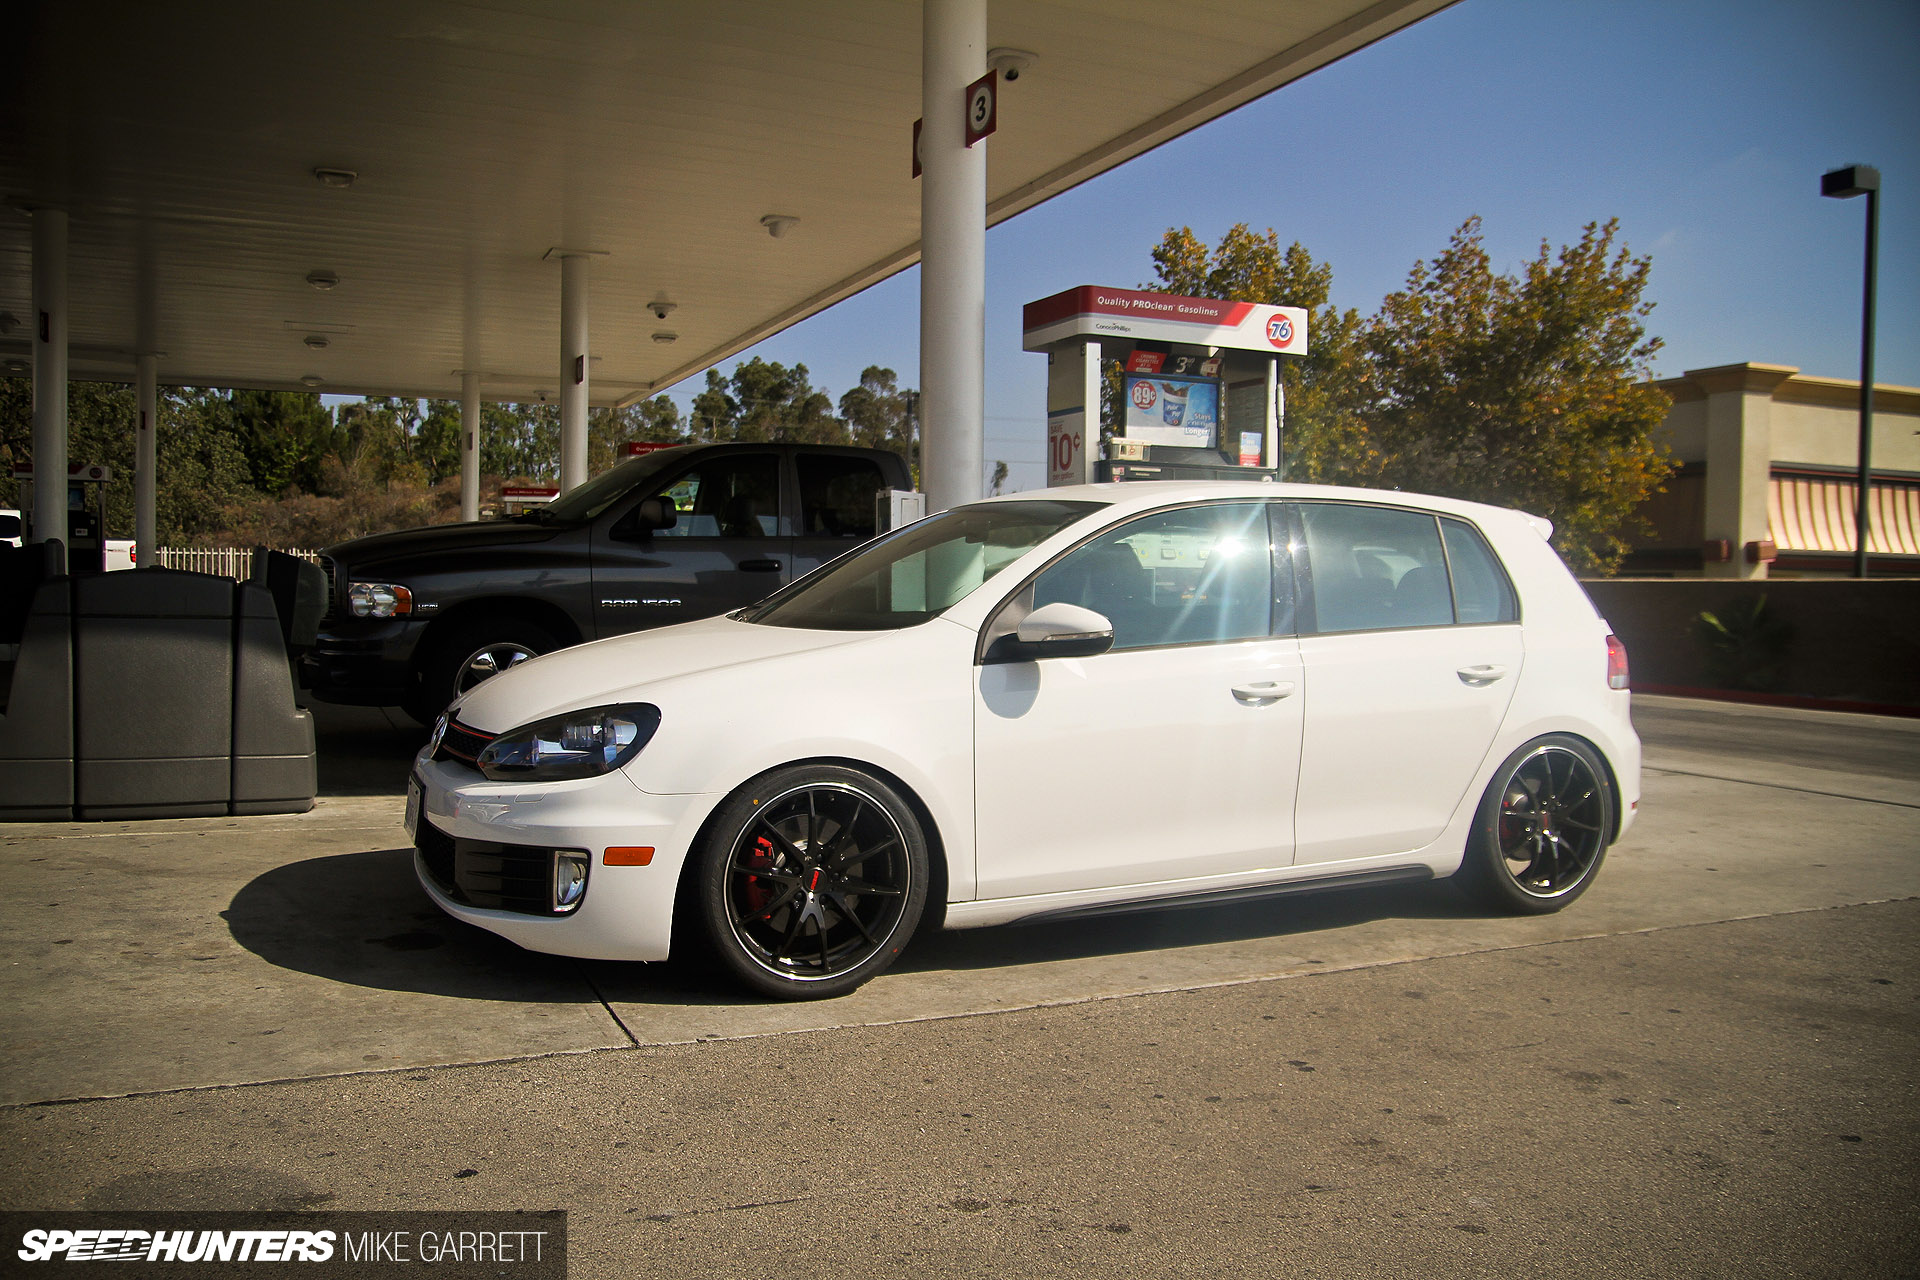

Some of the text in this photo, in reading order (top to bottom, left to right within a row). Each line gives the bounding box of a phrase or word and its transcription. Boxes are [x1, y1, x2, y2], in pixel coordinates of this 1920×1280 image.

[975, 95, 986, 122] 3
[1097, 296, 1219, 317] Quality PROclean Gasolines
[1095, 323, 1132, 332] ConocoPhillips
[1269, 320, 1292, 342] 76
[641, 599, 682, 608] 1500
